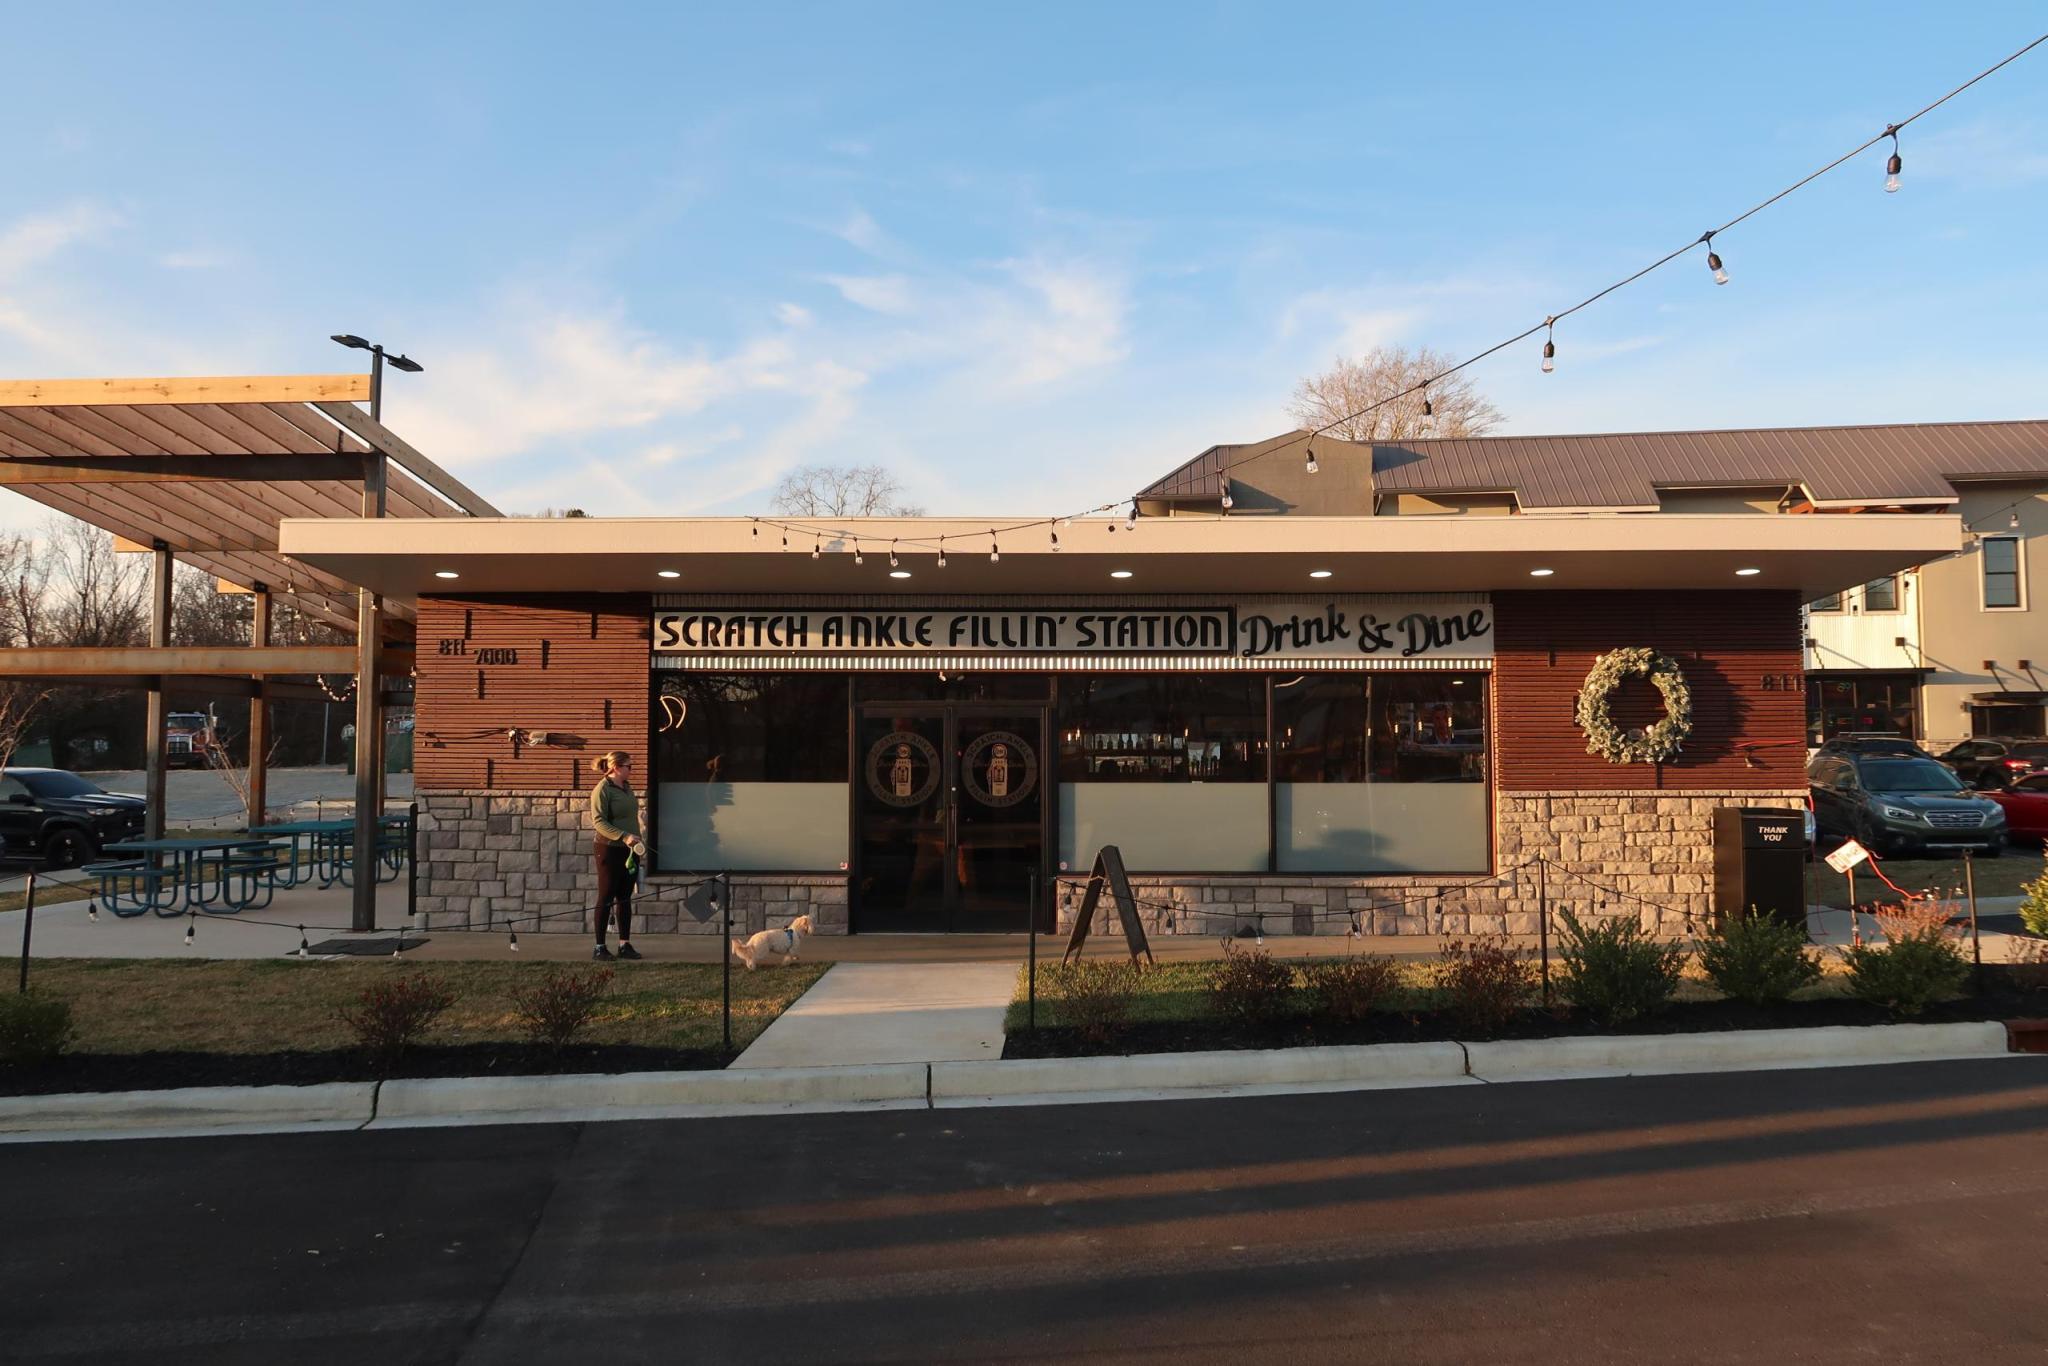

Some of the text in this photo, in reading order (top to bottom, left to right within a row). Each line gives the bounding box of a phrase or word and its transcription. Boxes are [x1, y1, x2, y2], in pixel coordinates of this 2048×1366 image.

[659, 615, 1222, 648] SCRATCH ANKLE FILLIN' STATION
[1239, 603, 1491, 657] Drink & Dine
[1761, 673, 1801, 691] 811
[1759, 826, 1788, 834] THANK
